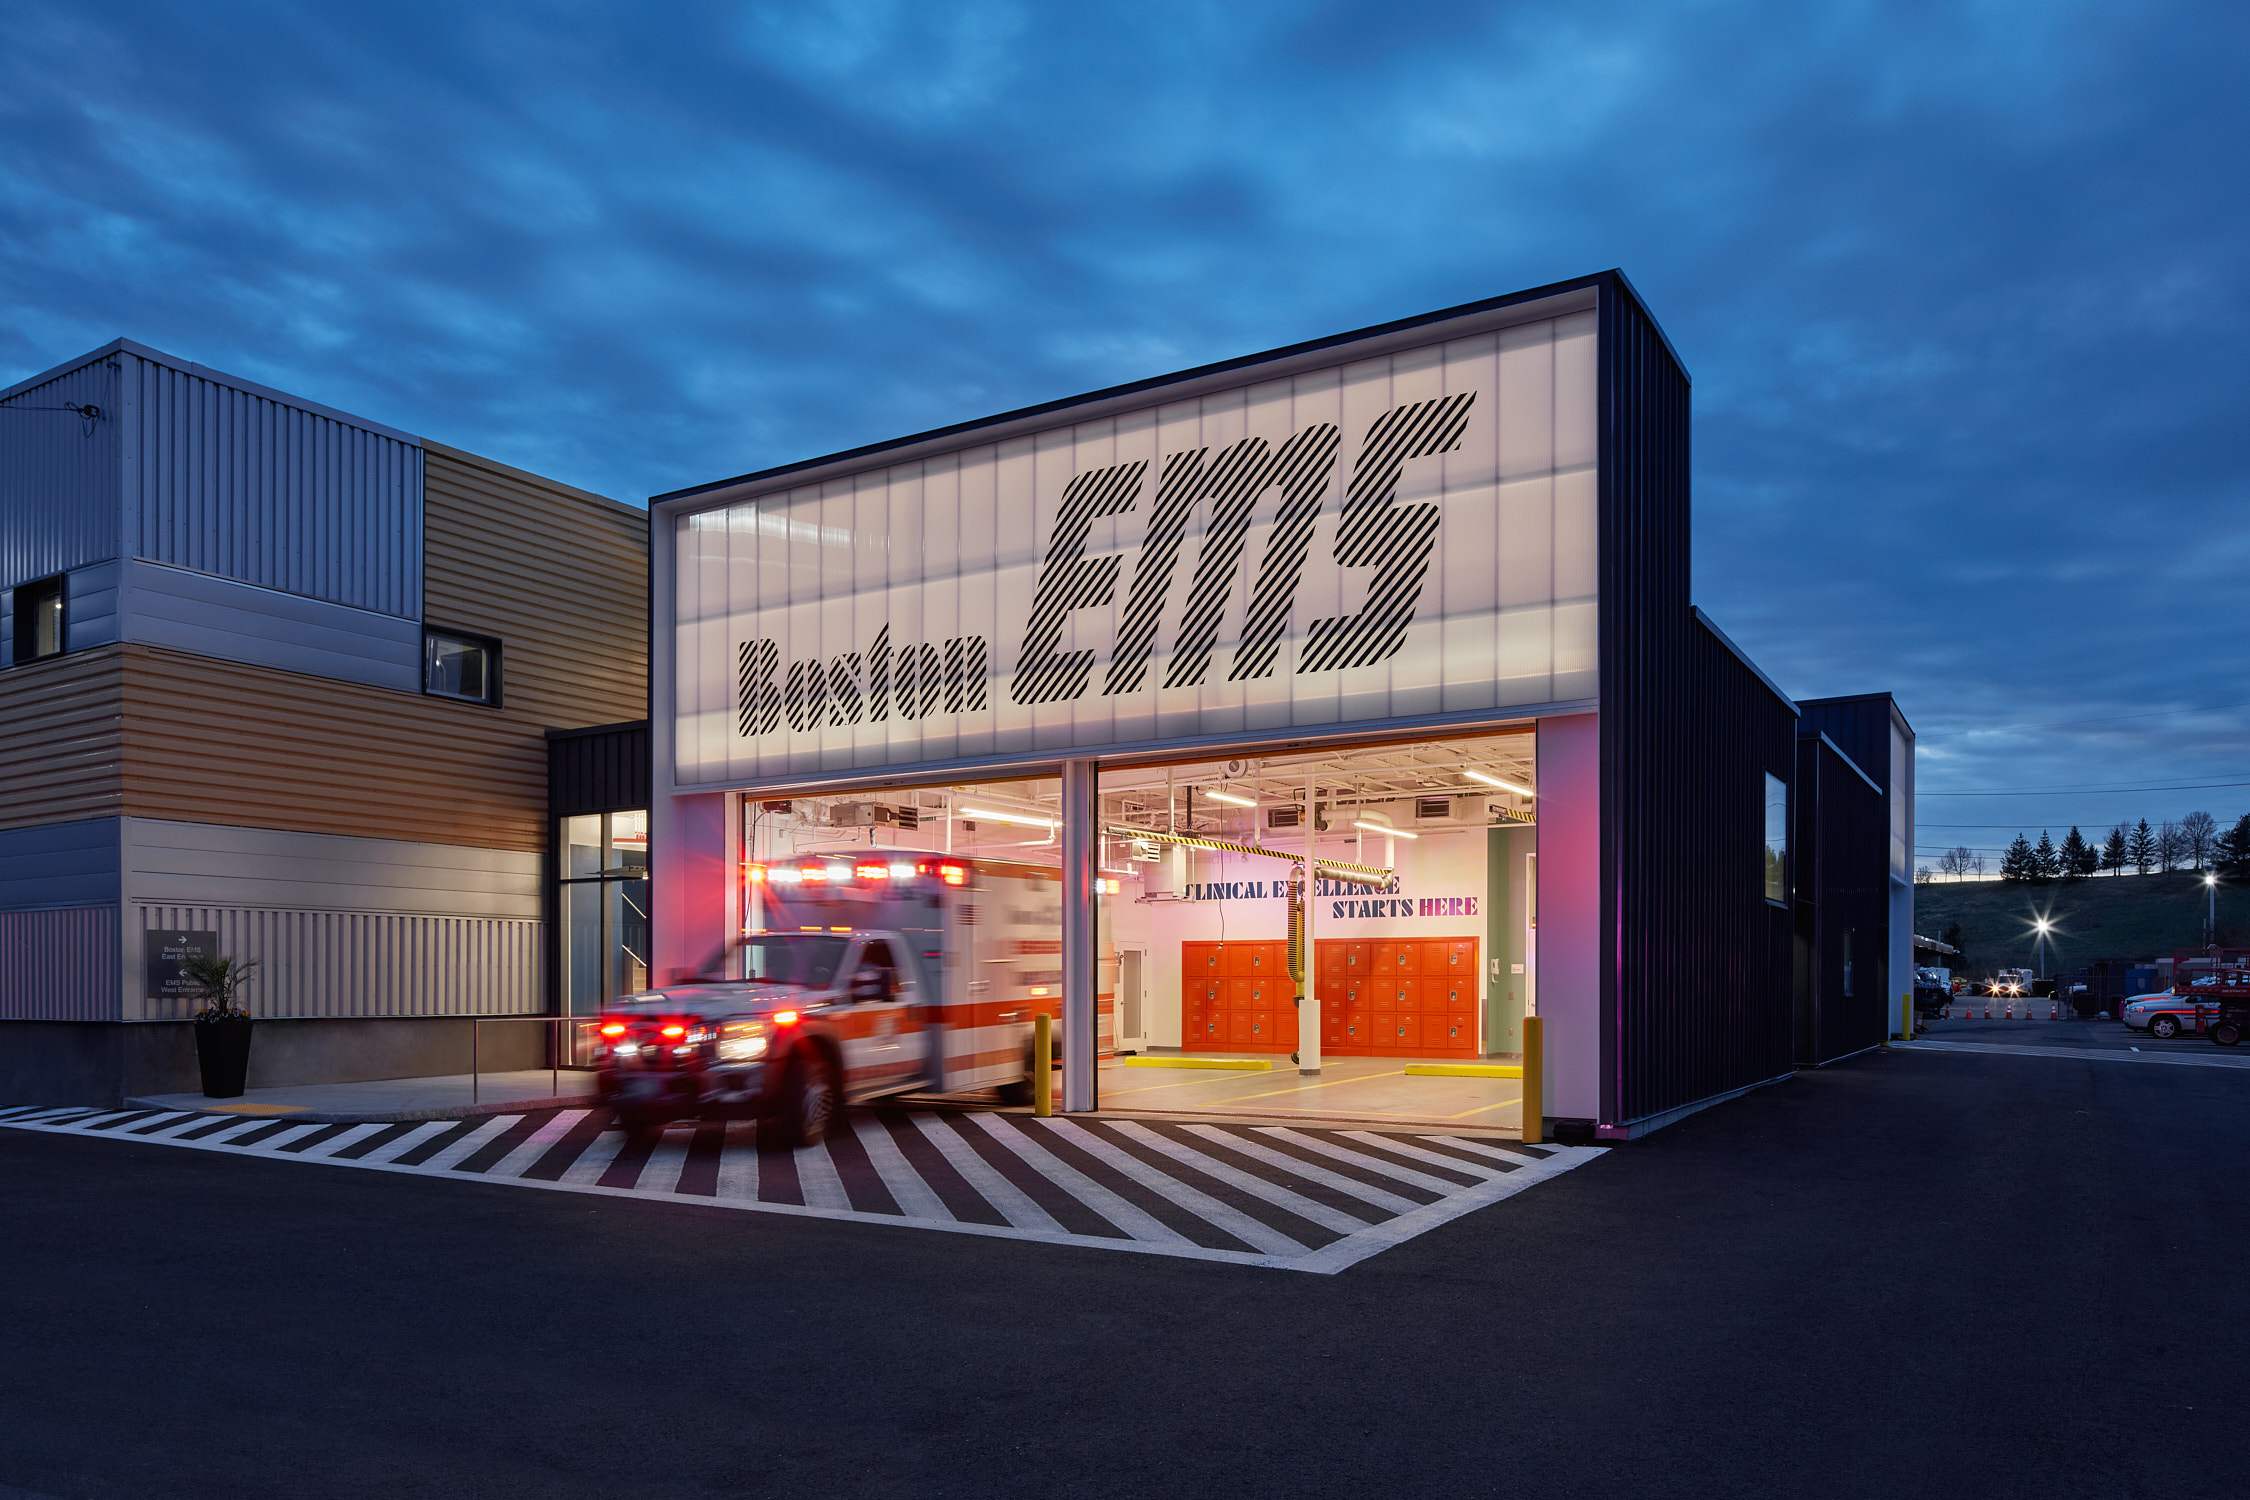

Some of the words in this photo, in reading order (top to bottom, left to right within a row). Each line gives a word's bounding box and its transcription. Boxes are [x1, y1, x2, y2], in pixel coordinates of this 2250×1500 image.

[738, 620, 987, 737] Boston
[1332, 899, 1413, 918] STARTS
[1419, 897, 1478, 916] HERE
